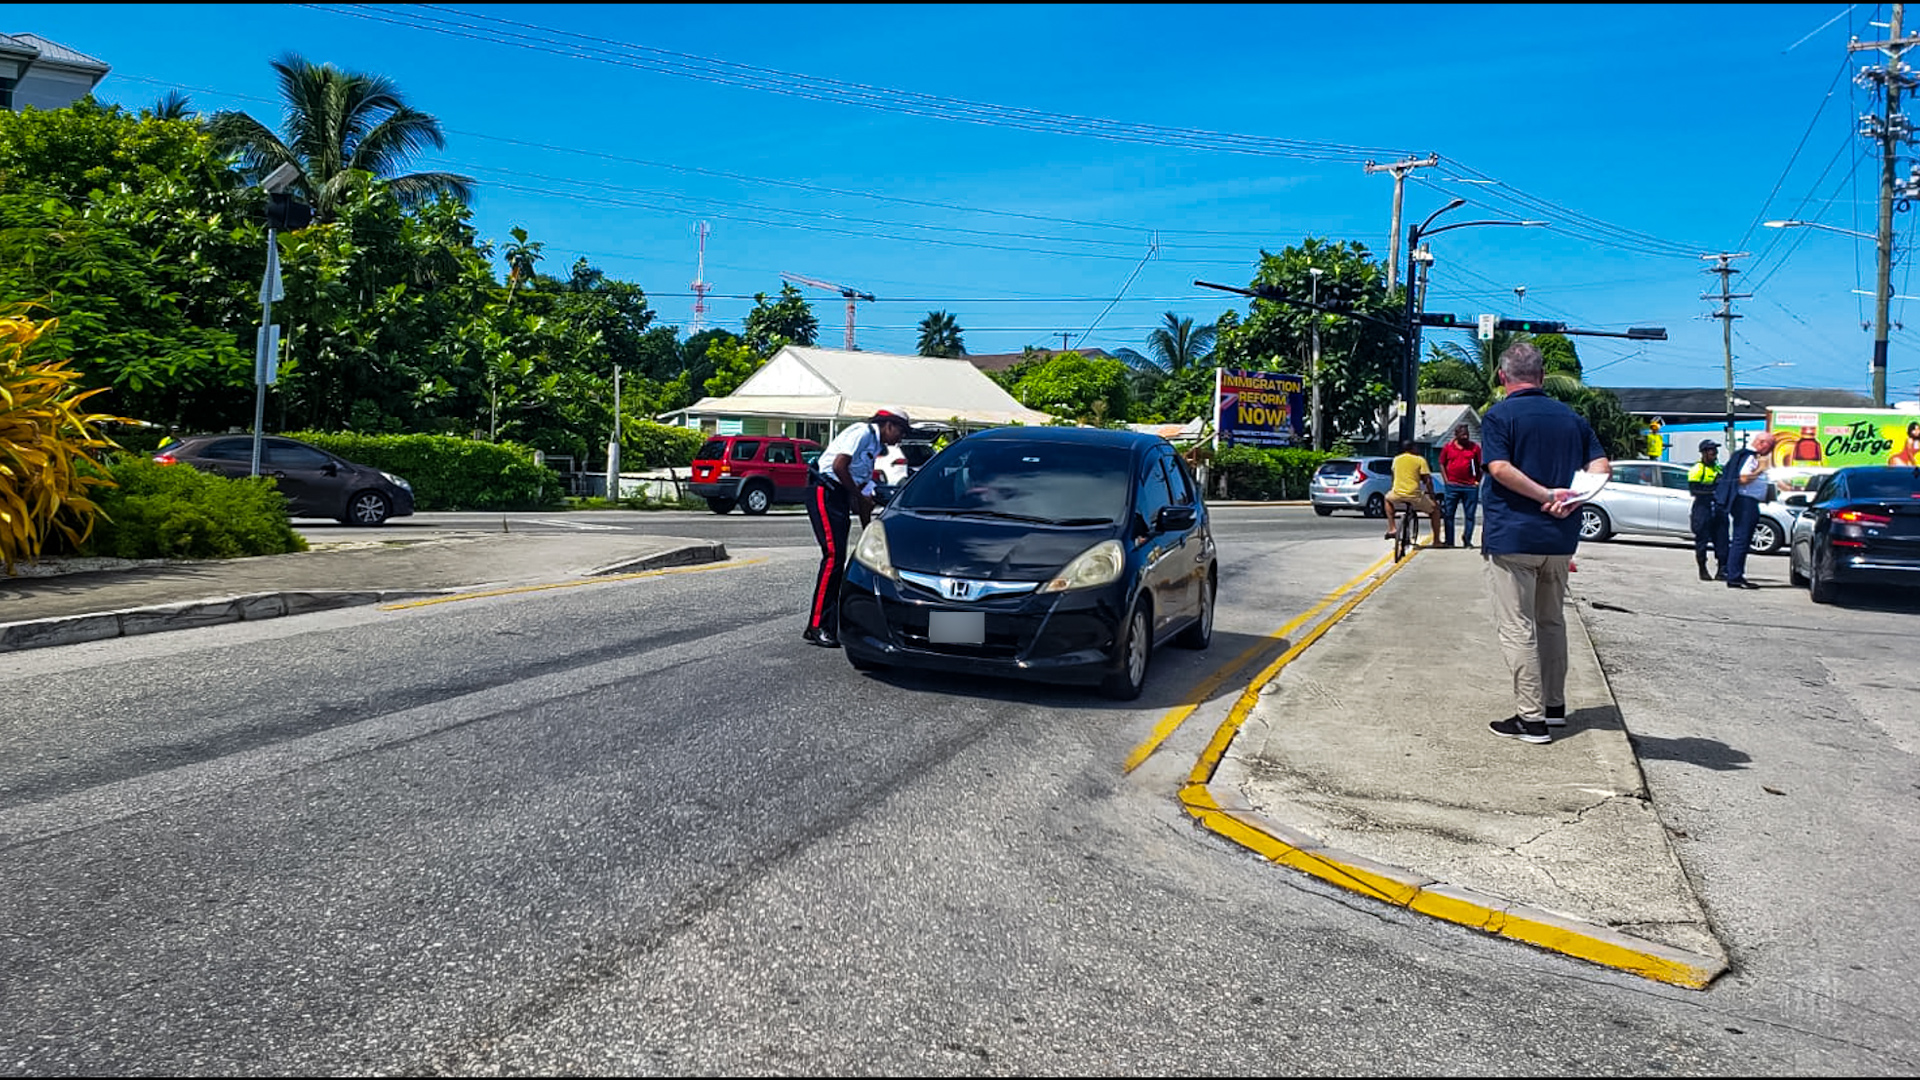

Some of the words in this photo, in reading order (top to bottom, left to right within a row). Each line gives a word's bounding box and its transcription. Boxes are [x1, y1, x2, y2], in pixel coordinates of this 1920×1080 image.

[1223, 375, 1301, 393] IMMIGRATION
[1238, 391, 1286, 405] REFORM
[1238, 406, 1286, 426] NOW!
[1825, 436, 1893, 456] Charge
